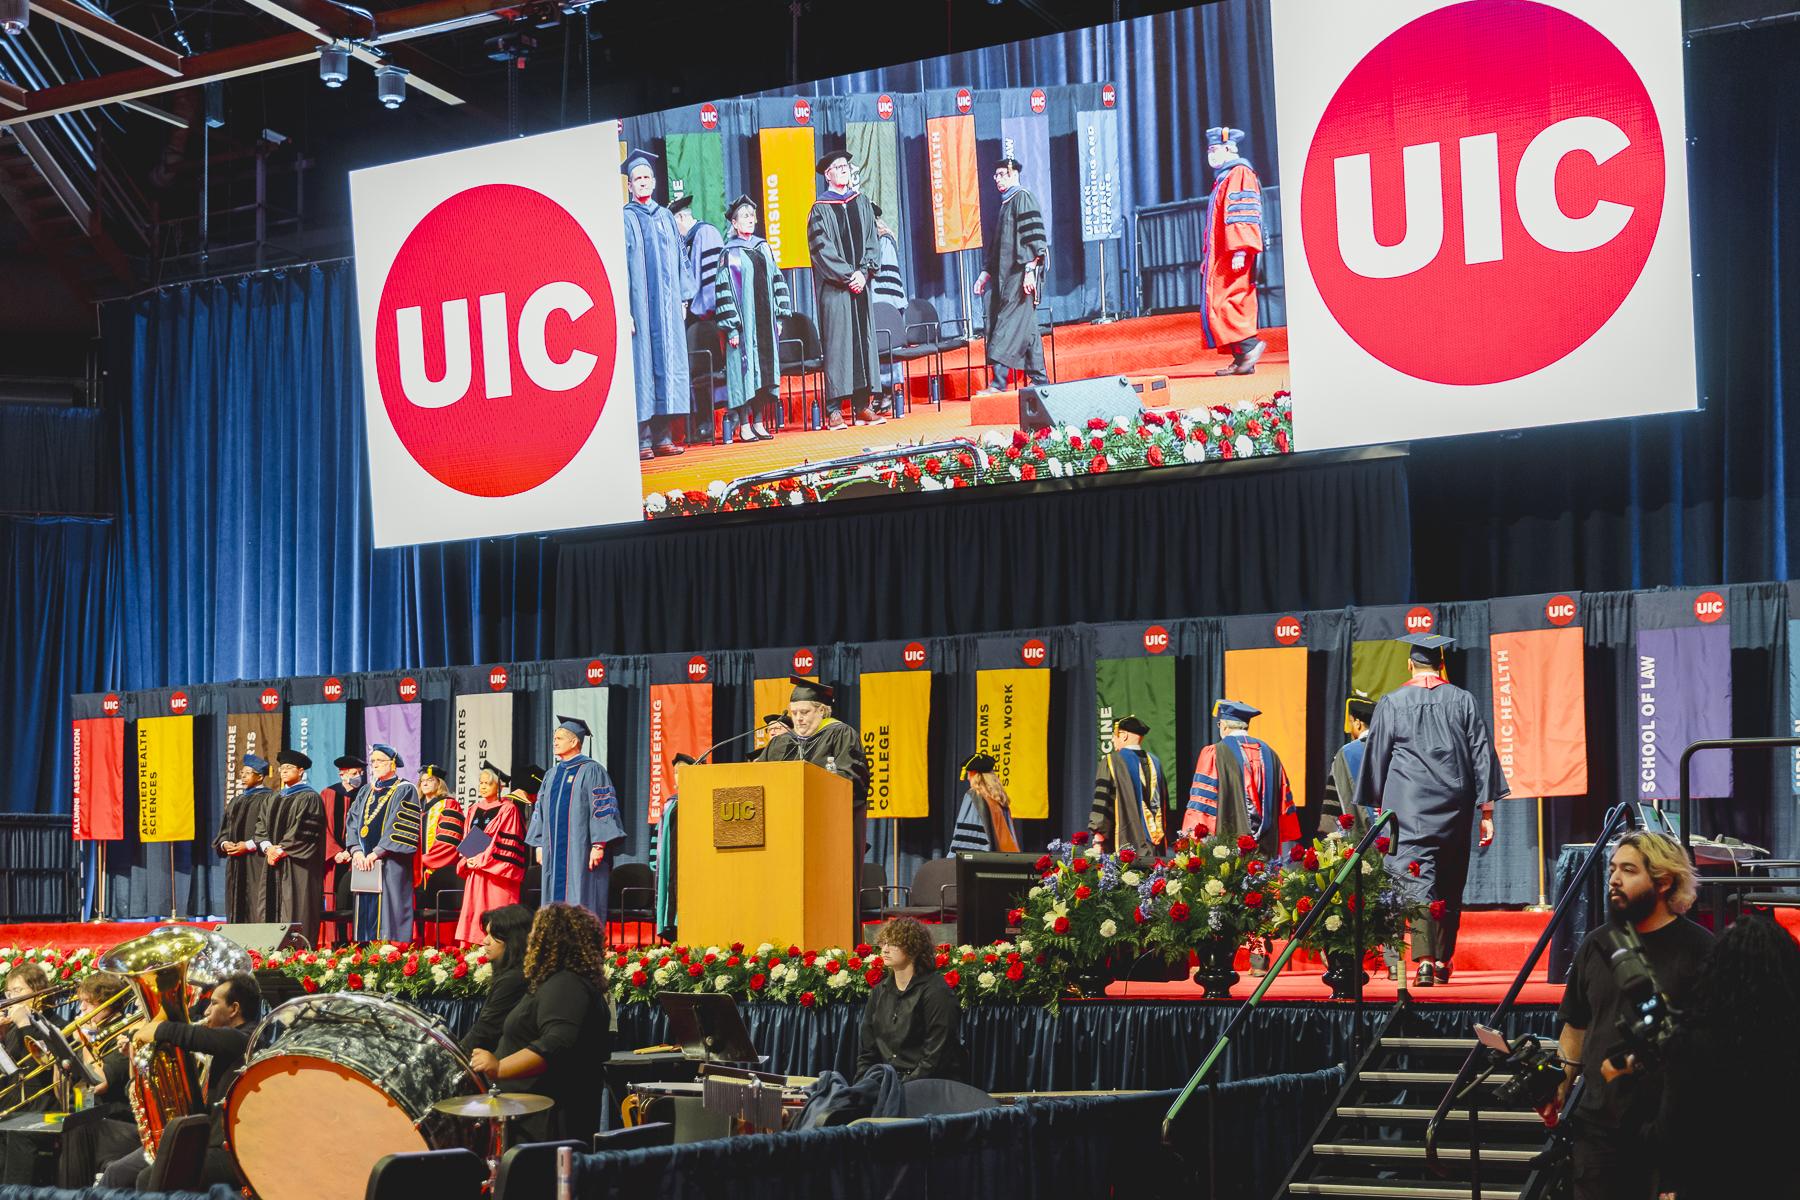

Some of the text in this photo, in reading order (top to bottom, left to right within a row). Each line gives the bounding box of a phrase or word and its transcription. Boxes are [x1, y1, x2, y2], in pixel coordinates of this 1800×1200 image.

[957, 95, 971, 107] UIC
[1031, 95, 1046, 107] UIC
[1103, 91, 1115, 101] UIC
[794, 106, 810, 118] UIC
[877, 101, 893, 113] UIC
[701, 110, 718, 123] UIC
[931, 132, 945, 247] PUBLIC HEALTH
[1333, 116, 1635, 279] UIC
[767, 174, 781, 262] NURSING
[396, 281, 599, 408] UIC
[1549, 605, 1573, 617] UIC
[1697, 602, 1722, 614] UIC
[1408, 616, 1431, 628] UIC
[1277, 626, 1299, 637] UIC
[1146, 634, 1167, 646] UIC
[905, 650, 924, 661] UIC
[1024, 648, 1044, 658] UIC
[795, 657, 813, 668] UIC
[588, 668, 603, 678] UIC
[689, 664, 706, 674] UIC
[491, 674, 506, 684] UIC
[325, 685, 341, 695] UIC
[401, 685, 416, 695] UIC
[104, 700, 119, 709] UIC
[171, 698, 187, 708] UIC
[262, 695, 277, 705] UIC
[1497, 650, 1513, 778] UBLIC HEALTH
[980, 704, 988, 756] DDAMS
[1641, 656, 1656, 793] SCHOOL OF LAW
[1003, 684, 1013, 787] SOCIAL WORK
[247, 732, 256, 755] RTS
[651, 700, 661, 817] ENGINEERING
[879, 725, 889, 810] COLLEGE
[720, 800, 756, 821] UIC
